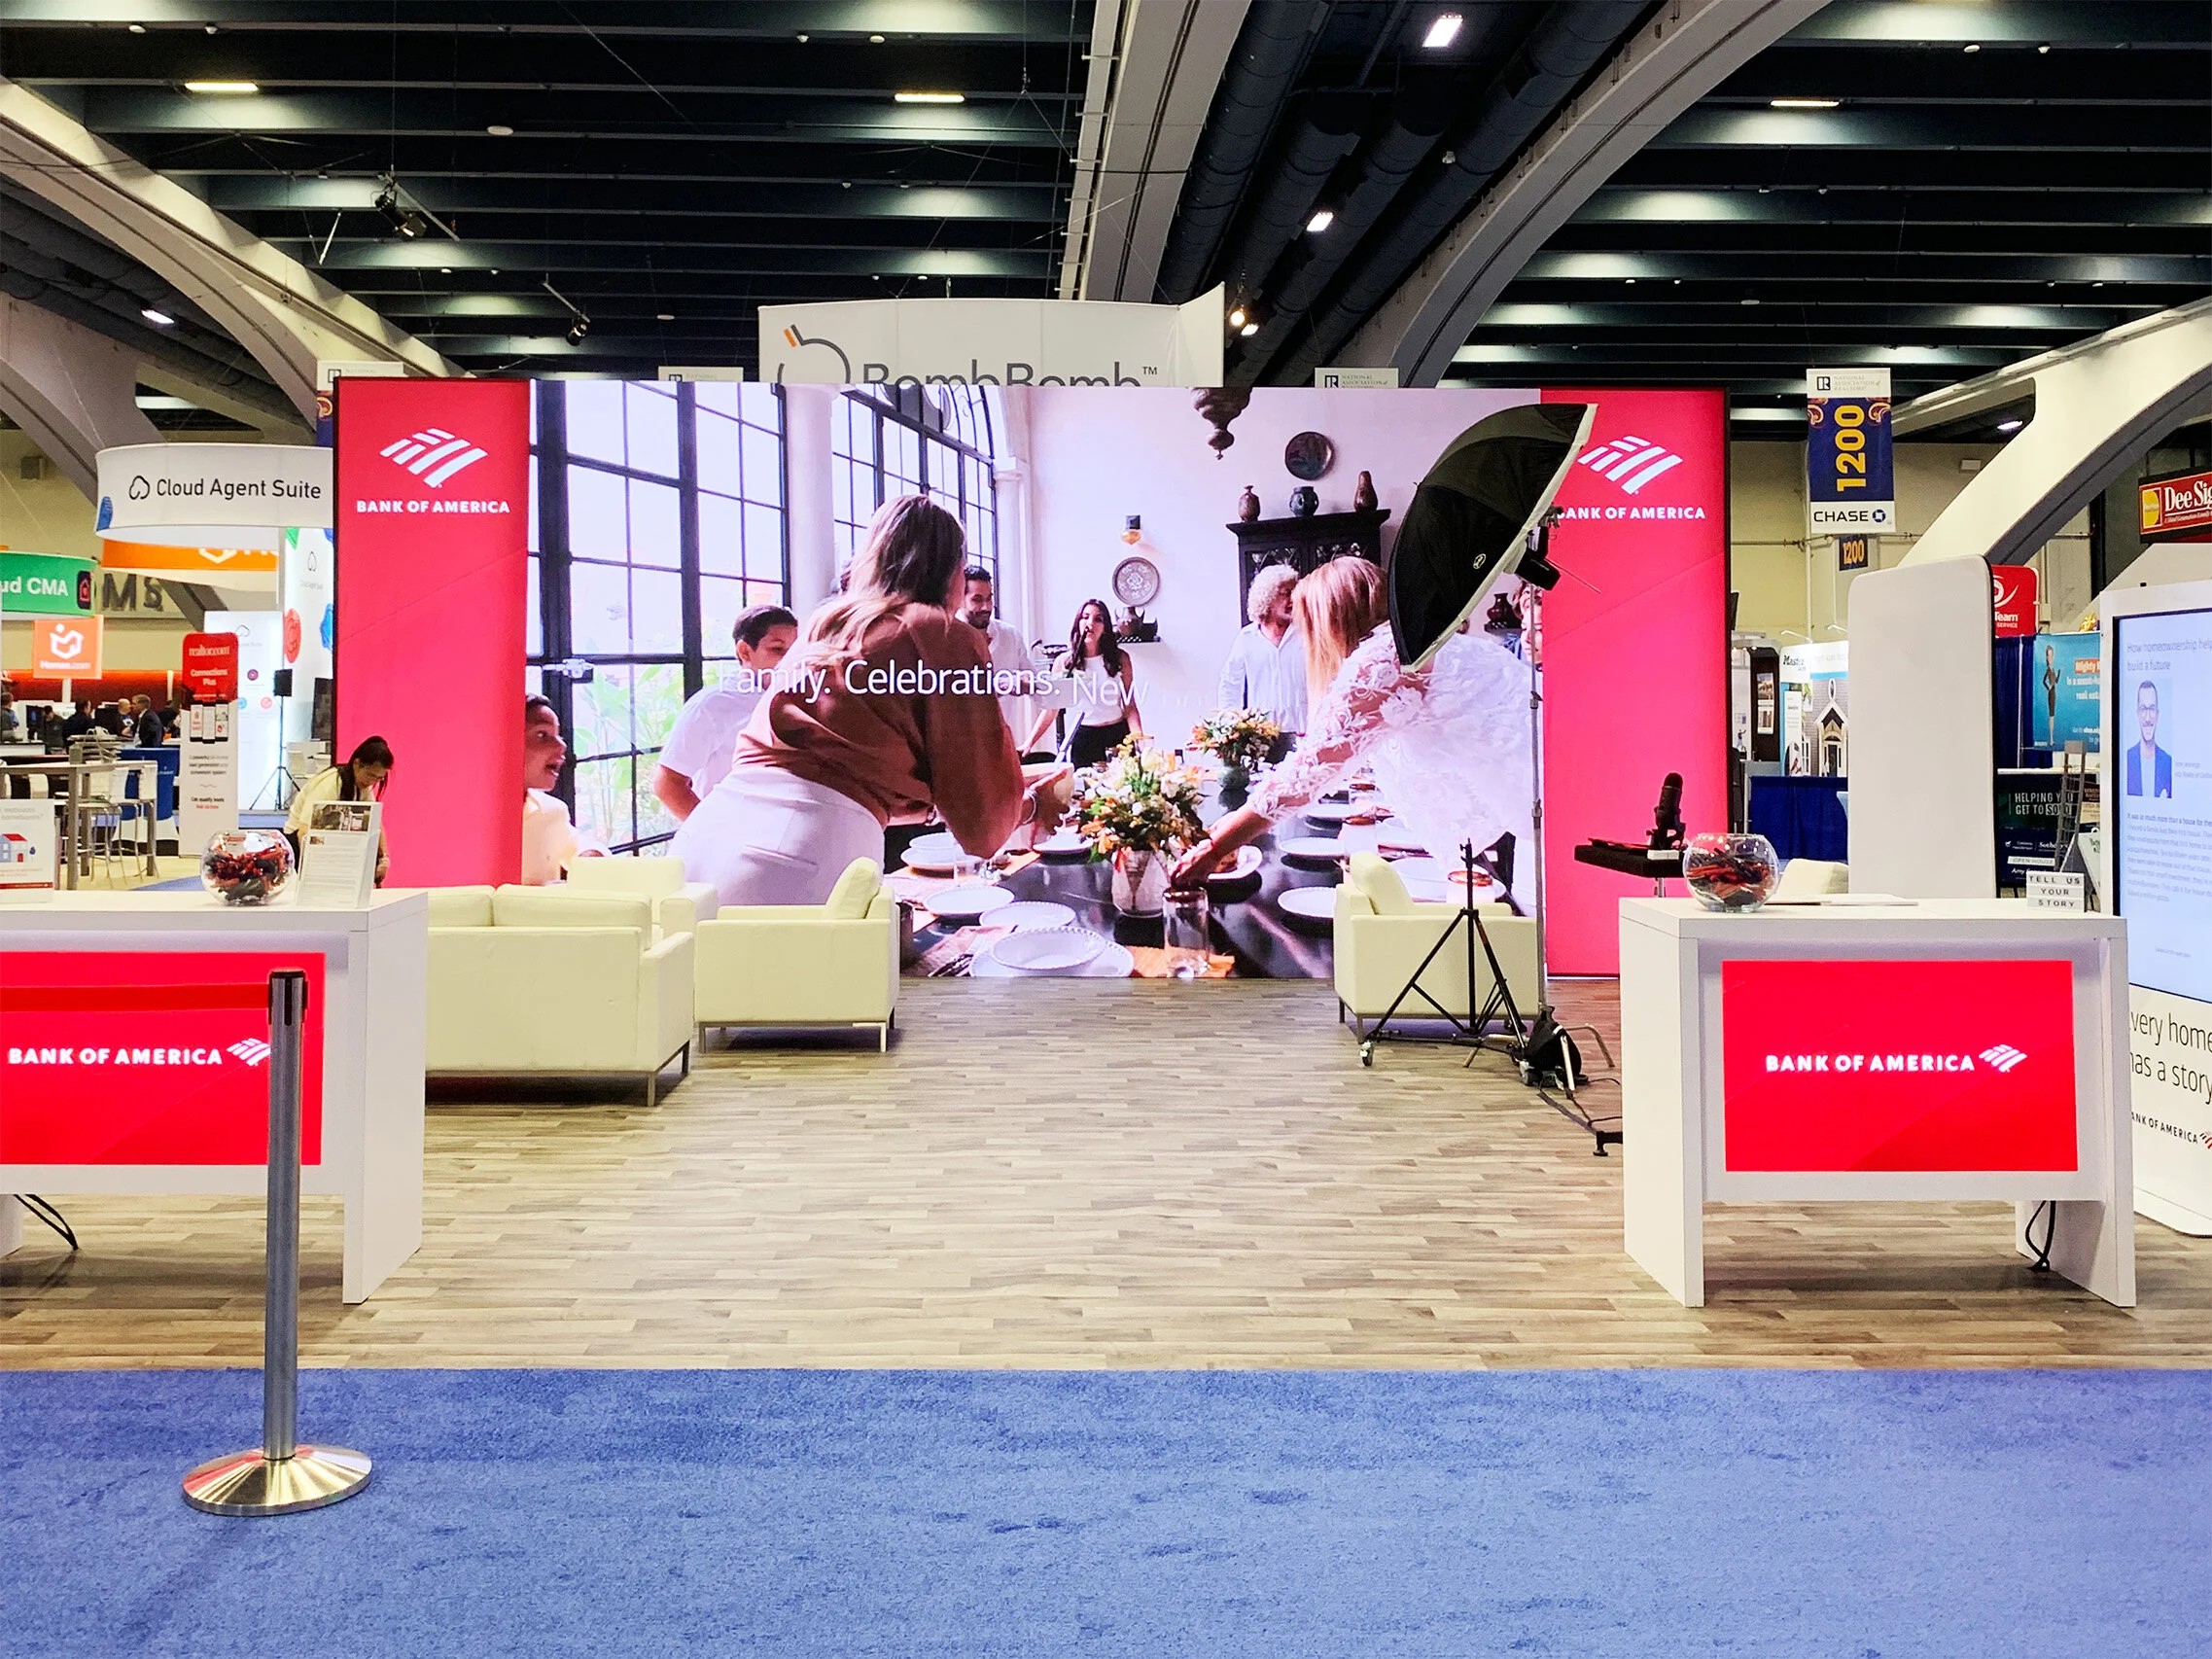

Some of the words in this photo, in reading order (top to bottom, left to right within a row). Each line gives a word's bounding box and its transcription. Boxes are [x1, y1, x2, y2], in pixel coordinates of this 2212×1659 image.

[1834, 405, 1867, 492] 1200
[157, 478, 204, 497] Cloud
[210, 478, 266, 500] Agent
[271, 479, 322, 499] Suite
[2164, 486, 2193, 512] Dee
[356, 500, 404, 513] BANK
[406, 500, 429, 513] OF
[432, 501, 510, 513] AMERICA
[1604, 507, 1627, 519] OF
[1630, 507, 1705, 519] AMERICA
[1813, 511, 1869, 522] CHASE
[1843, 539, 1864, 565] 1200
[27, 577, 69, 596] CMA
[94, 573, 162, 608] MS
[40, 661, 91, 670] Homes.com
[719, 660, 831, 704] Family.
[844, 658, 1061, 696] Celebrations.
[1071, 672, 1150, 708] New
[2015, 793, 2054, 803] HELPING
[2055, 793, 2074, 802] YU
[2016, 804, 2030, 815] GET
[2033, 804, 2044, 815] TO
[2047, 804, 2071, 815] SOD
[2130, 1011, 2163, 1046] very
[8, 1047, 74, 1065] BANK
[81, 1047, 110, 1065] OF
[114, 1048, 223, 1065] AMERICA
[1766, 1055, 1829, 1072] BANK
[1834, 1055, 1864, 1072] OF
[1869, 1055, 1975, 1072] AMERICA
[2157, 1061, 2166, 1081] a
[2171, 1064, 2212, 1105] story
[2131, 1112, 2147, 1125] ANK
[2148, 1119, 2159, 1129] OF
[2159, 1122, 2198, 1144] AMERICA
